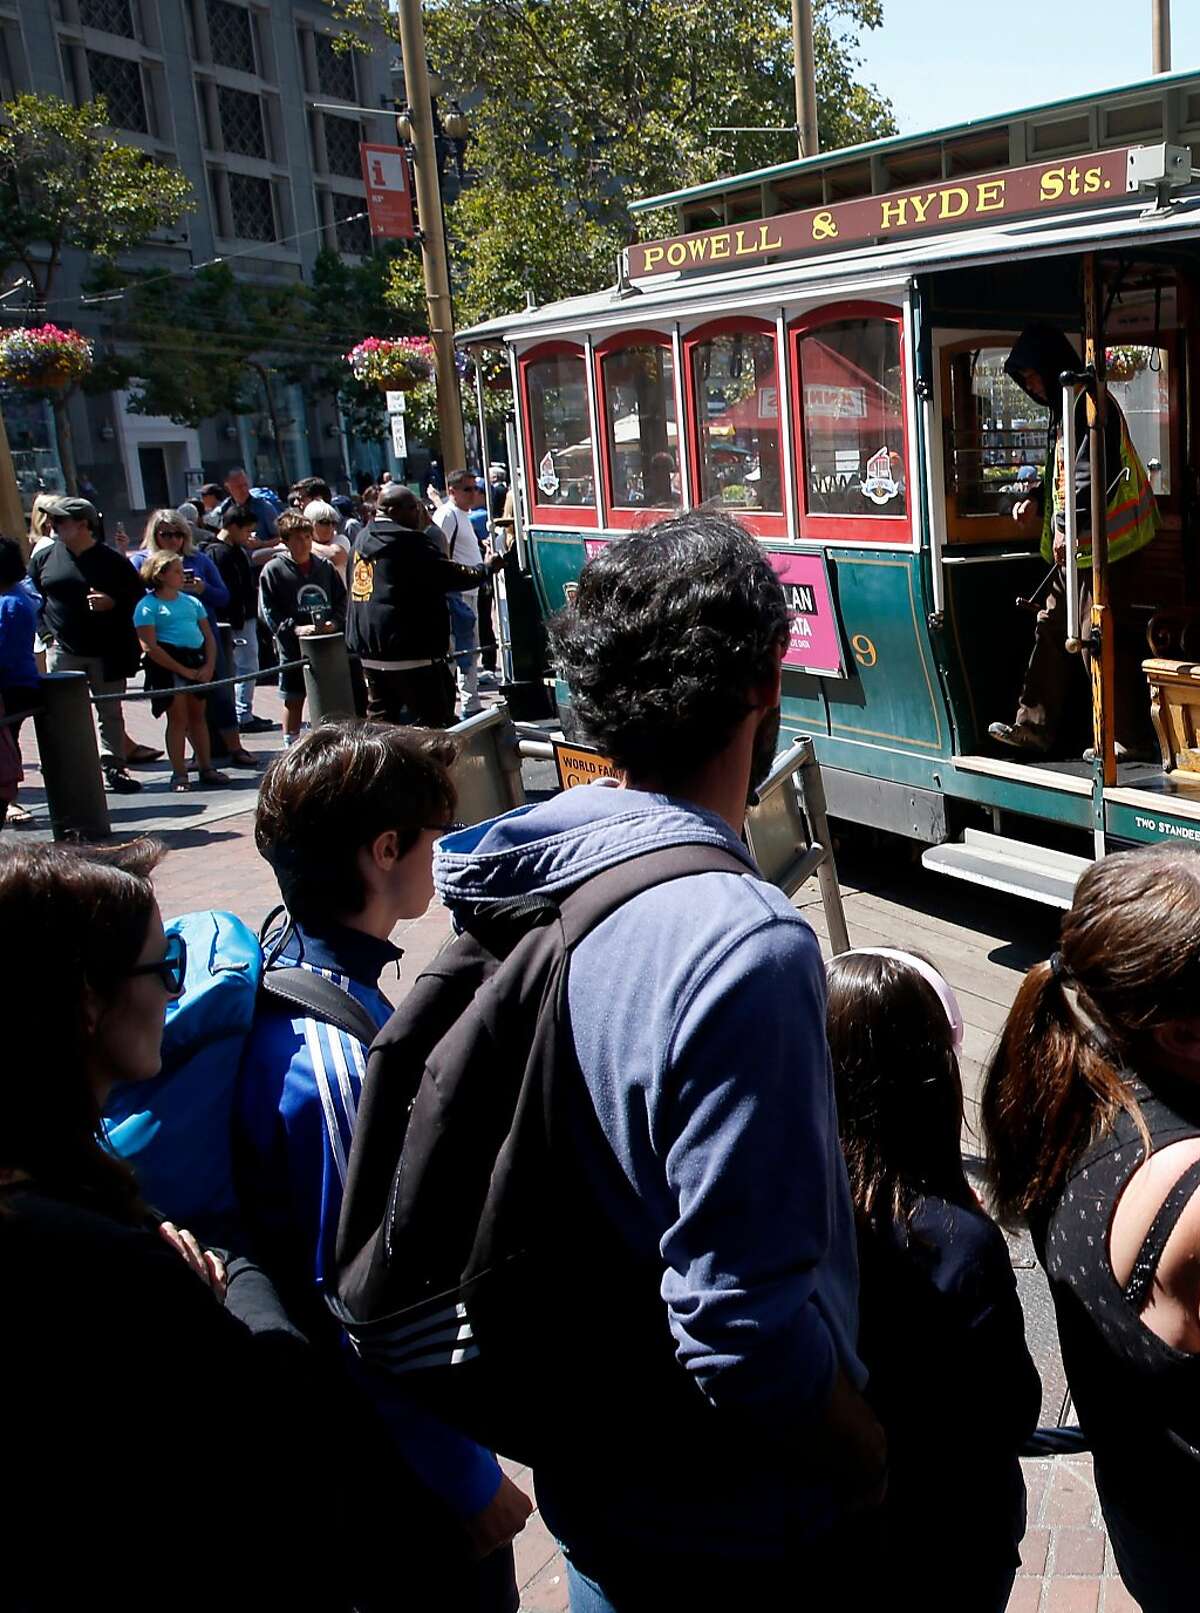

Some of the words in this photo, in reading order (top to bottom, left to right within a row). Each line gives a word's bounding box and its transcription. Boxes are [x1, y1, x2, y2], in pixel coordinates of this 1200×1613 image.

[643, 226, 783, 272] POWELL
[812, 211, 839, 240] &
[880, 180, 1006, 229] HYDE
[1040, 166, 1111, 201] Sts.
[781, 585, 813, 611] LAN
[789, 616, 812, 637] ATA
[851, 634, 878, 668] 9
[563, 756, 596, 774] WORLD
[1134, 816, 1156, 831] TWO
